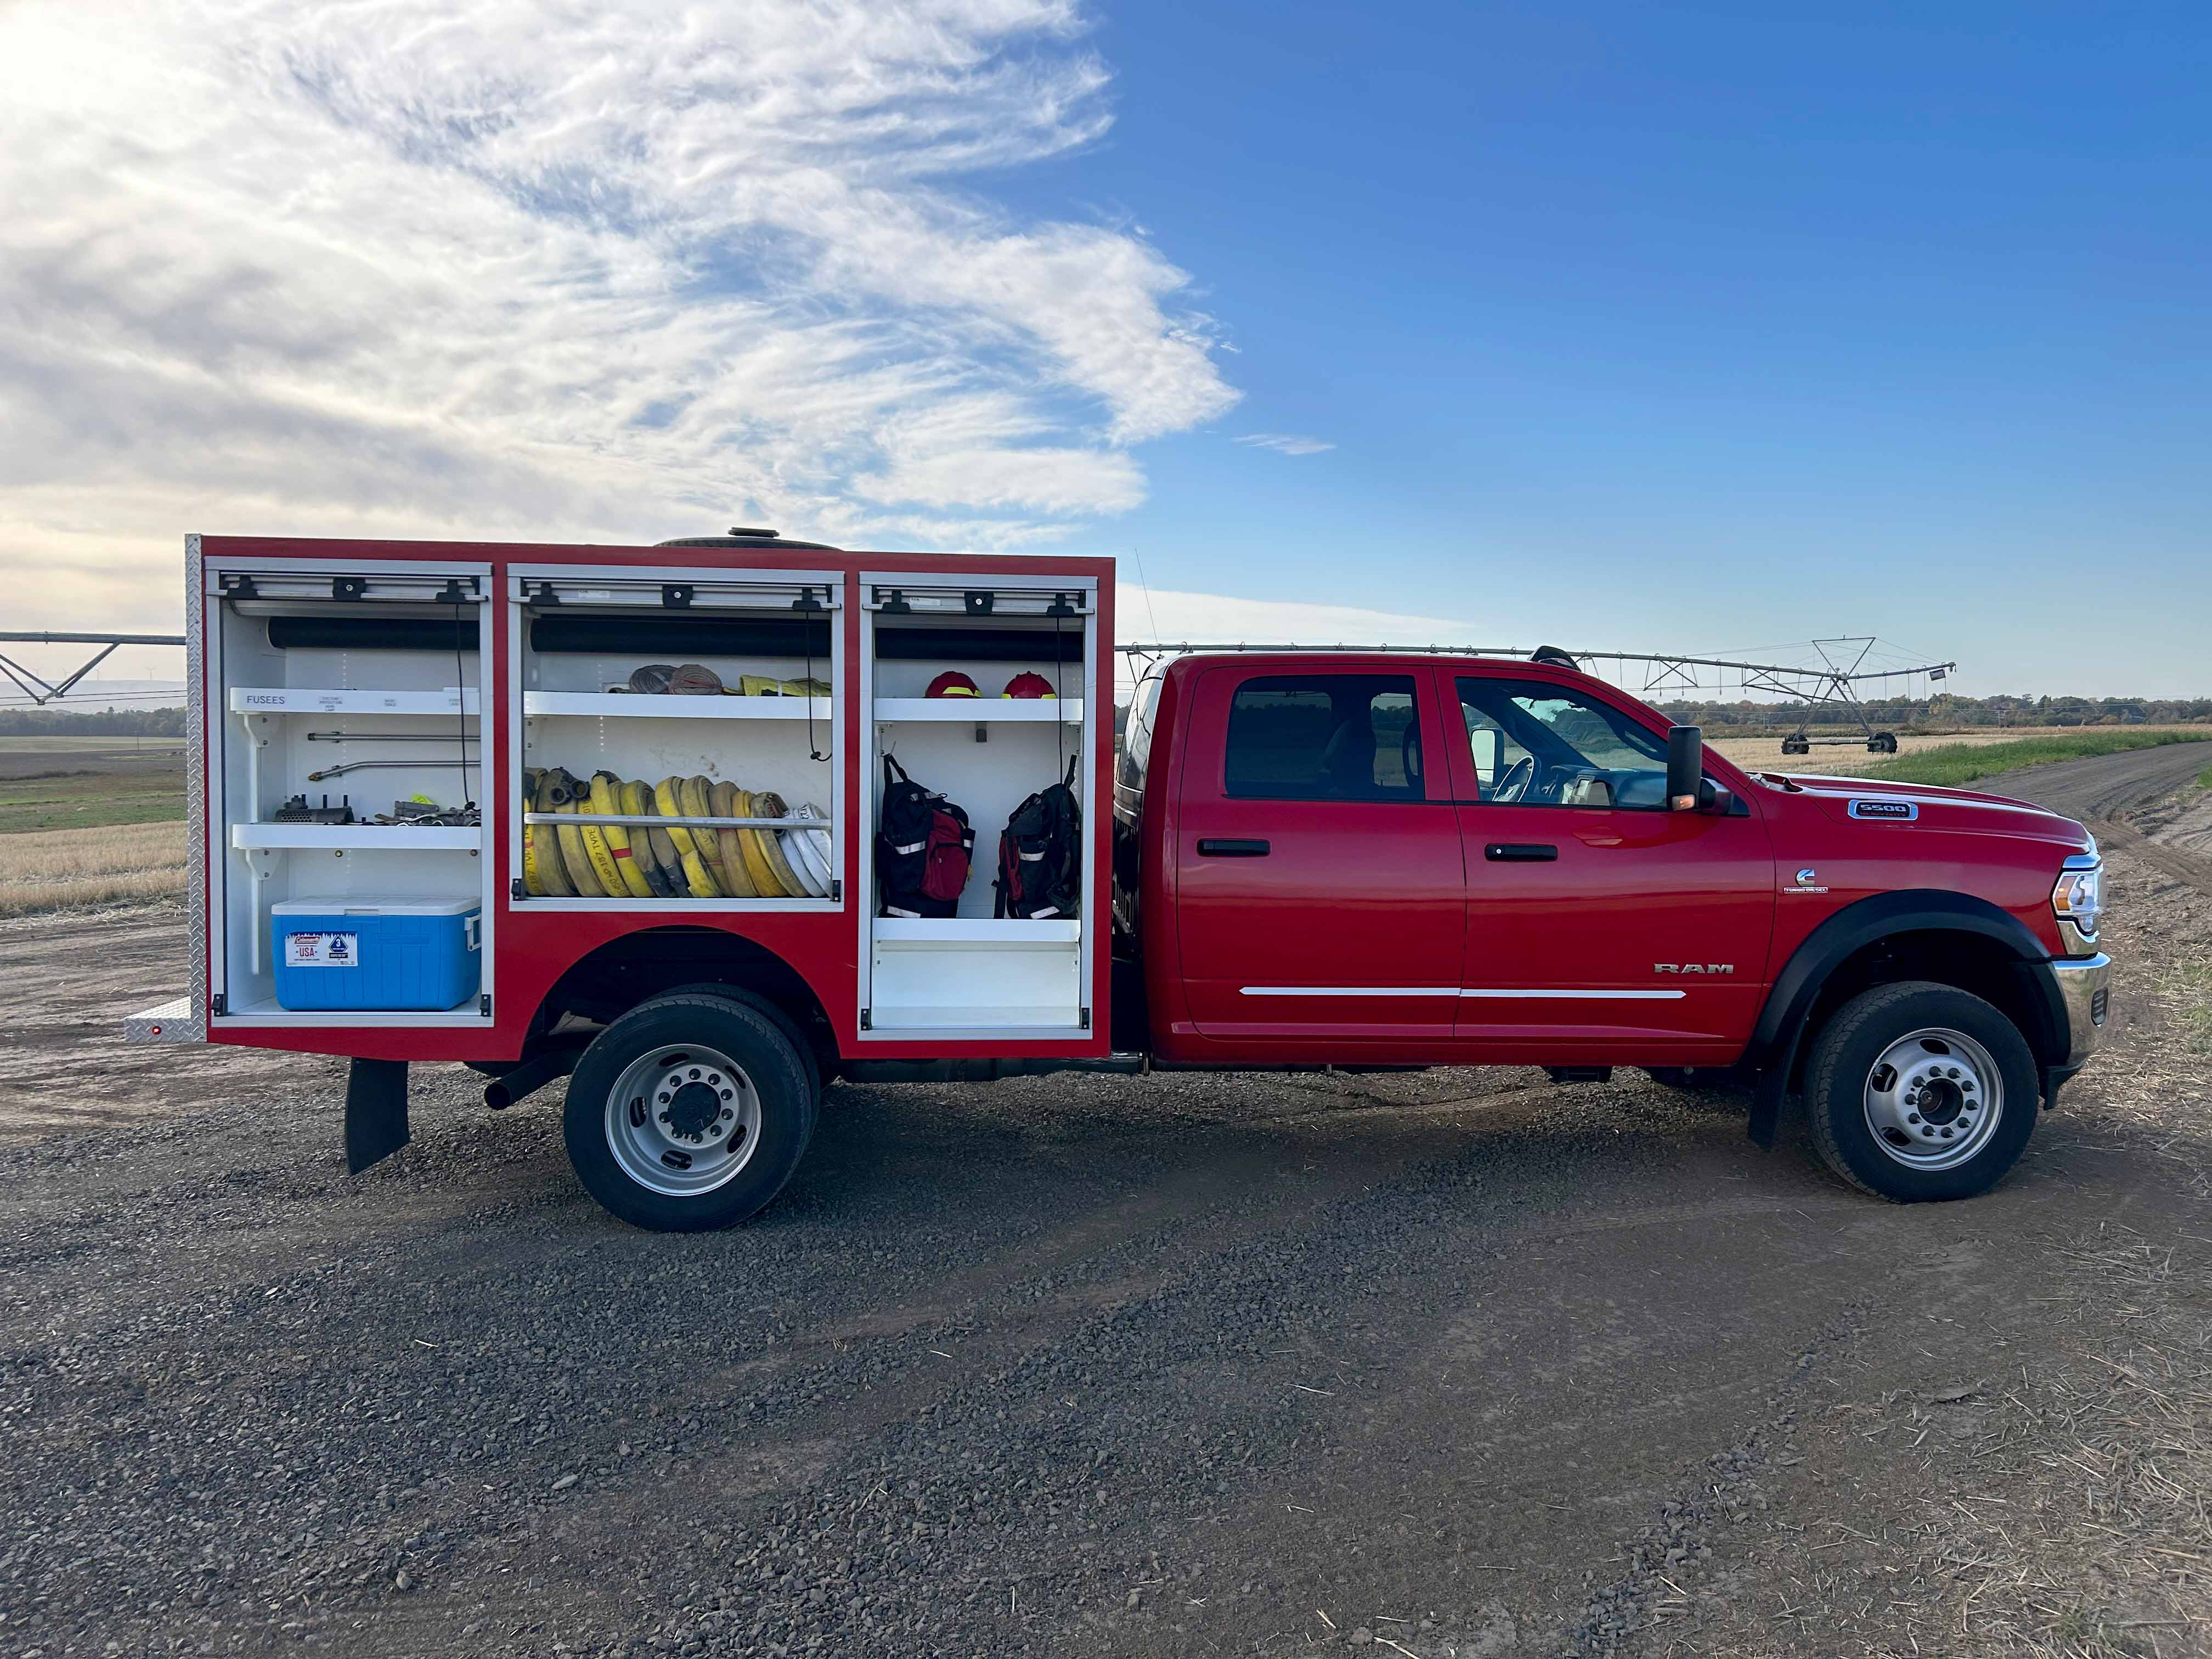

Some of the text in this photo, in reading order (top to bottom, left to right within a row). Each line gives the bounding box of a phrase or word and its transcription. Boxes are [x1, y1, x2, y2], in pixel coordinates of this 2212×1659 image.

[246, 695, 285, 704] FUSEES
[1860, 804, 1906, 812] 5500
[588, 829, 600, 849] TYPE
[336, 939, 341, 947] 3
[299, 947, 314, 957] USA
[1654, 963, 1734, 974] RAM
